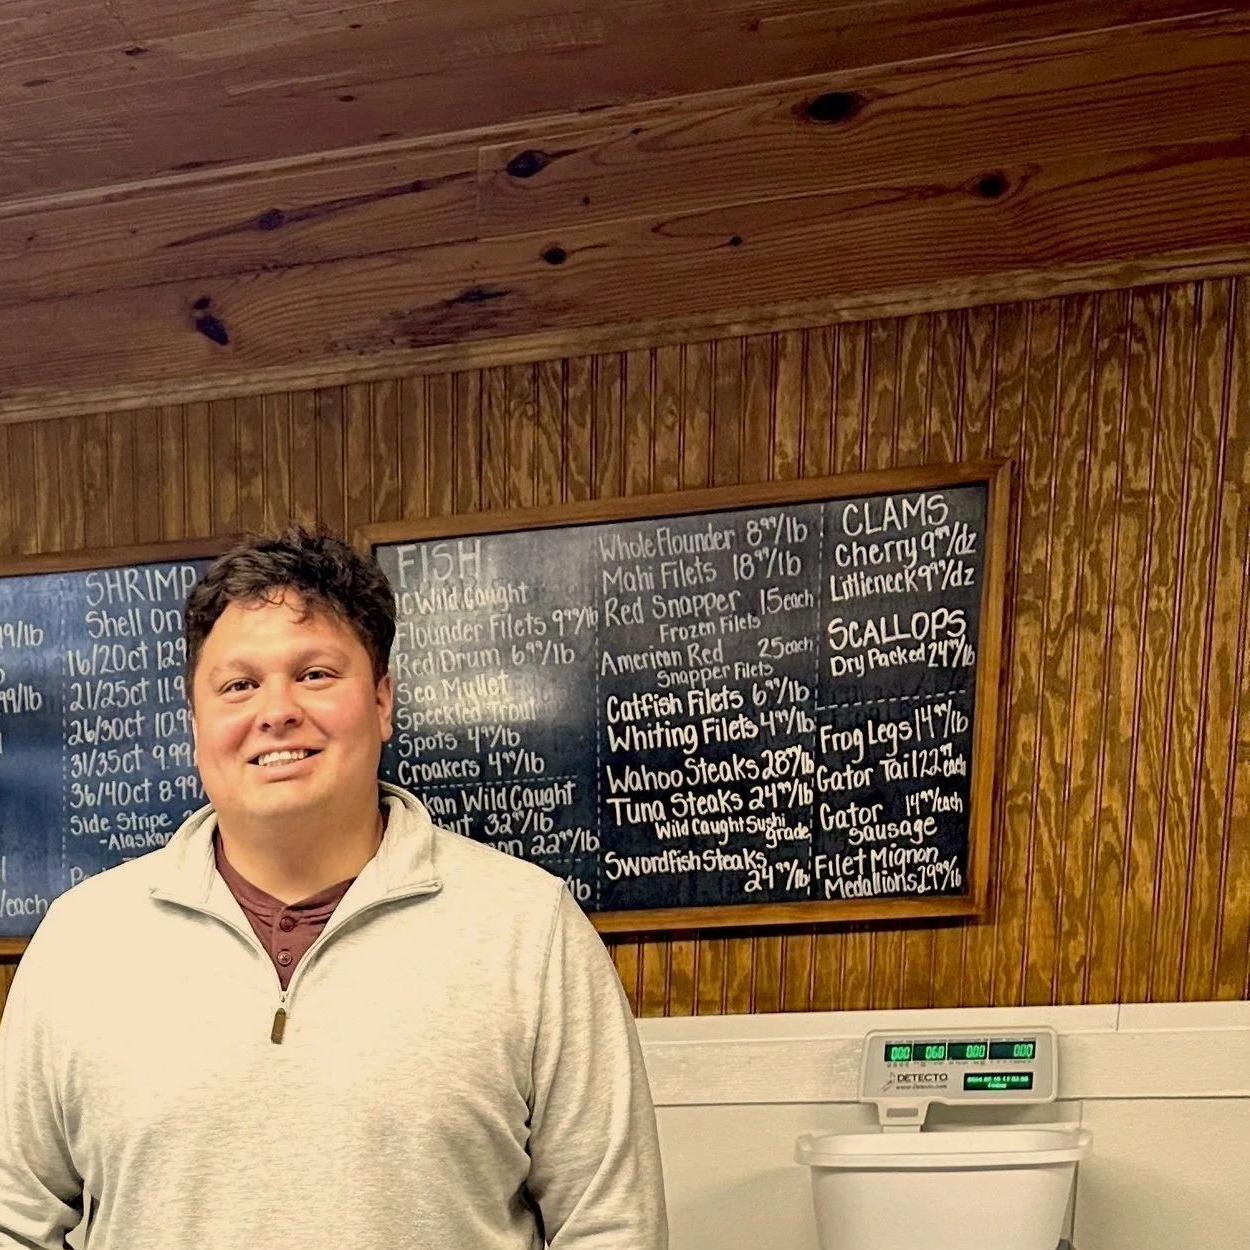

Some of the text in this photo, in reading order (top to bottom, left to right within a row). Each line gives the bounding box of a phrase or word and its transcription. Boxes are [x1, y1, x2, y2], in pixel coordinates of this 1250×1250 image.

[842, 493, 948, 536] CLAMS
[600, 532, 656, 562] Whole
[657, 523, 735, 556] Flounder
[397, 539, 480, 588] FISH
[603, 565, 654, 595] Mahi
[661, 557, 717, 589] Filets
[85, 566, 197, 607] SHRIMP
[415, 586, 459, 615] Wild
[464, 582, 528, 611] Caught
[85, 608, 183, 639] Shell On
[604, 596, 644, 627] Red
[652, 590, 741, 620] Snapper
[394, 619, 483, 650] Flounder
[490, 612, 547, 641] Filets
[659, 613, 761, 643] Frozen Filets
[827, 607, 966, 650] SCALLOPS
[396, 652, 434, 679] Red
[441, 648, 500, 672] Drum
[601, 645, 682, 676] American
[687, 639, 723, 667] Red
[657, 660, 774, 689] Snapper Filets
[830, 654, 864, 677] Dry
[868, 642, 925, 669] Packed
[397, 670, 509, 705] Sea Mullet
[607, 692, 683, 724] Catfish
[687, 685, 744, 717] Filets
[397, 702, 481, 731] Speckled
[607, 720, 698, 755] Whiting
[702, 713, 759, 744] Filets
[398, 731, 457, 757] Spots
[820, 725, 864, 764] Frog
[867, 720, 913, 757] Legs
[398, 758, 480, 785] Croakers
[606, 764, 683, 794] Wahoo
[684, 754, 760, 787] Steaks
[816, 764, 874, 792] Gator
[879, 750, 918, 782] Tail
[462, 787, 507, 813] Wild
[510, 781, 576, 811] Caught
[606, 797, 666, 826] Tuna
[670, 789, 743, 818] Steaks
[70, 811, 172, 835] Side Stripe
[654, 812, 786, 846] Wild Caught Sushi
[820, 802, 883, 831] Gator
[605, 848, 767, 881] Swordfish Steaks
[814, 842, 939, 880] Filet Mignon
[824, 870, 918, 900] Medallions
[897, 1073, 948, 1083] DETECTO
